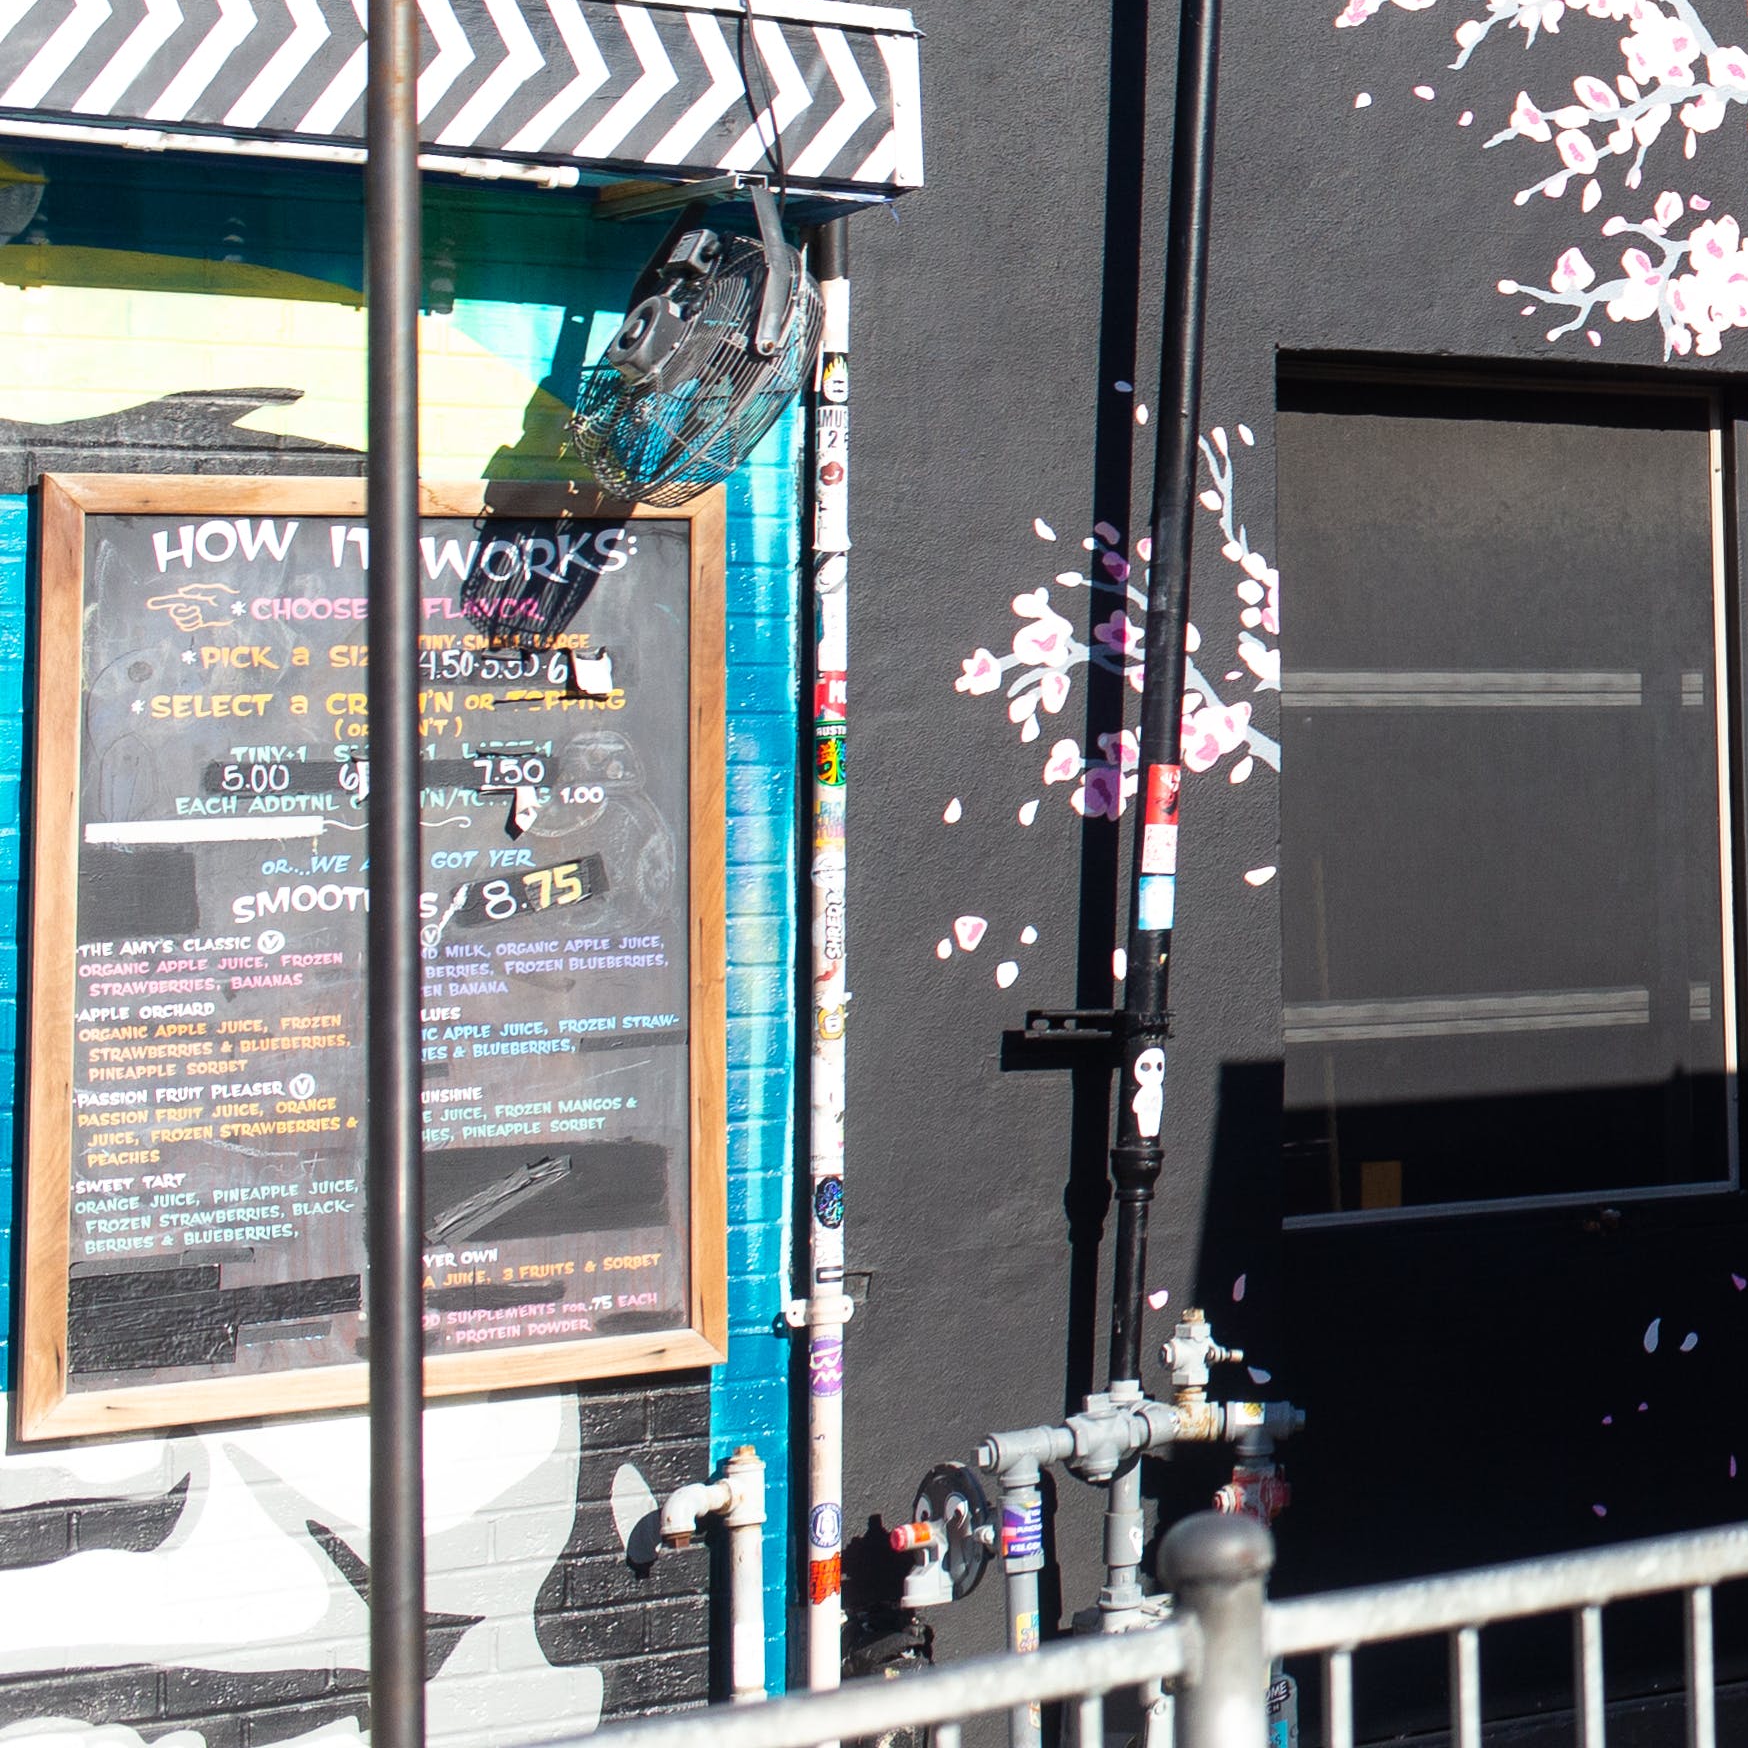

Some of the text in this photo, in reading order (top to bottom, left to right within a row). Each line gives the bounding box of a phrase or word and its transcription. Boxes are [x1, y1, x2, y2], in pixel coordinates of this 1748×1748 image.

[152, 519, 638, 584] HOW IT WORKS:
[251, 598, 369, 621] CHOOSE
[200, 645, 369, 669] PICK a SI
[150, 693, 274, 719] SELECT
[289, 694, 309, 715] a
[464, 694, 497, 711] OR
[221, 764, 290, 793] 5.00
[473, 758, 545, 785] 7.50
[175, 796, 238, 816] EACH
[248, 794, 341, 814] ADDTNL
[560, 786, 604, 804] 1.00
[430, 848, 537, 869] GOT YER
[482, 863, 583, 920] 8.75
[79, 942, 114, 957] THE
[120, 939, 174, 956] AMY'S
[182, 937, 251, 952] CLASSIC
[446, 945, 491, 958] MILK,
[496, 939, 560, 956] ORGANIC
[563, 939, 611, 953] APPLE
[618, 935, 665, 951] JUICE,
[79, 952, 343, 978] ORGANIC APPLE JUICE, FROZEN
[505, 958, 564, 975] FROZEN
[568, 954, 669, 972] BLUEBERRIES,
[89, 973, 303, 997] STRAWBERRIES, BANANAS
[449, 981, 509, 996] BANANA
[78, 1002, 215, 1022] APPLE ORCHARD
[420, 1006, 462, 1022] LUES
[79, 1015, 342, 1042] ORGANIC APPLE JUICE, FROZEN
[442, 1024, 491, 1041] APPLE
[499, 1021, 549, 1038] JUICE,
[558, 1016, 616, 1033] FROZEN
[622, 1013, 680, 1029] STRAW-
[89, 1034, 351, 1062] STRAWBERRIES & BLUEBERRIES,
[452, 1046, 466, 1058] &
[472, 1037, 576, 1056] BLUEBERRIES,
[88, 1059, 248, 1082] PINEAPPLE SORBET
[78, 1090, 148, 1108] PASSION
[156, 1085, 205, 1102] FRUIT
[211, 1081, 285, 1099] PLEASER
[420, 1087, 483, 1103] UNSHINE
[78, 1097, 336, 1127] PASSION FRUIT JUICE, ORANGE
[440, 1107, 487, 1122] JUICE,
[495, 1101, 552, 1118] FROZEN
[558, 1097, 622, 1113] MANGOS
[626, 1098, 639, 1108] &
[87, 1117, 358, 1147] JUICE, FROZEN STRAWBERRIES &
[462, 1122, 542, 1140] PINEAPPLE
[550, 1117, 606, 1133] SORBET
[87, 1149, 161, 1167] PEACHES
[75, 1173, 187, 1194] SWEET TART
[75, 1179, 360, 1215] ORANGE JUICE, PINEAPPLE JUICE,
[85, 1199, 355, 1235] FROZEN STRAWBERRIES, BLACK-
[85, 1223, 300, 1255] BERRIES & BLUEBERRIES,
[423, 1249, 498, 1268] YER OWN
[443, 1270, 492, 1286] JUICE,
[503, 1268, 514, 1281] 3
[518, 1262, 575, 1279] FRUITS
[584, 1261, 598, 1274] &
[603, 1253, 662, 1271] SORBET
[447, 1303, 556, 1325] SUPPLEMENTS
[562, 1303, 588, 1313] FOR
[618, 1293, 658, 1308] EACH
[456, 1319, 592, 1344] PROTEIN POWDER
